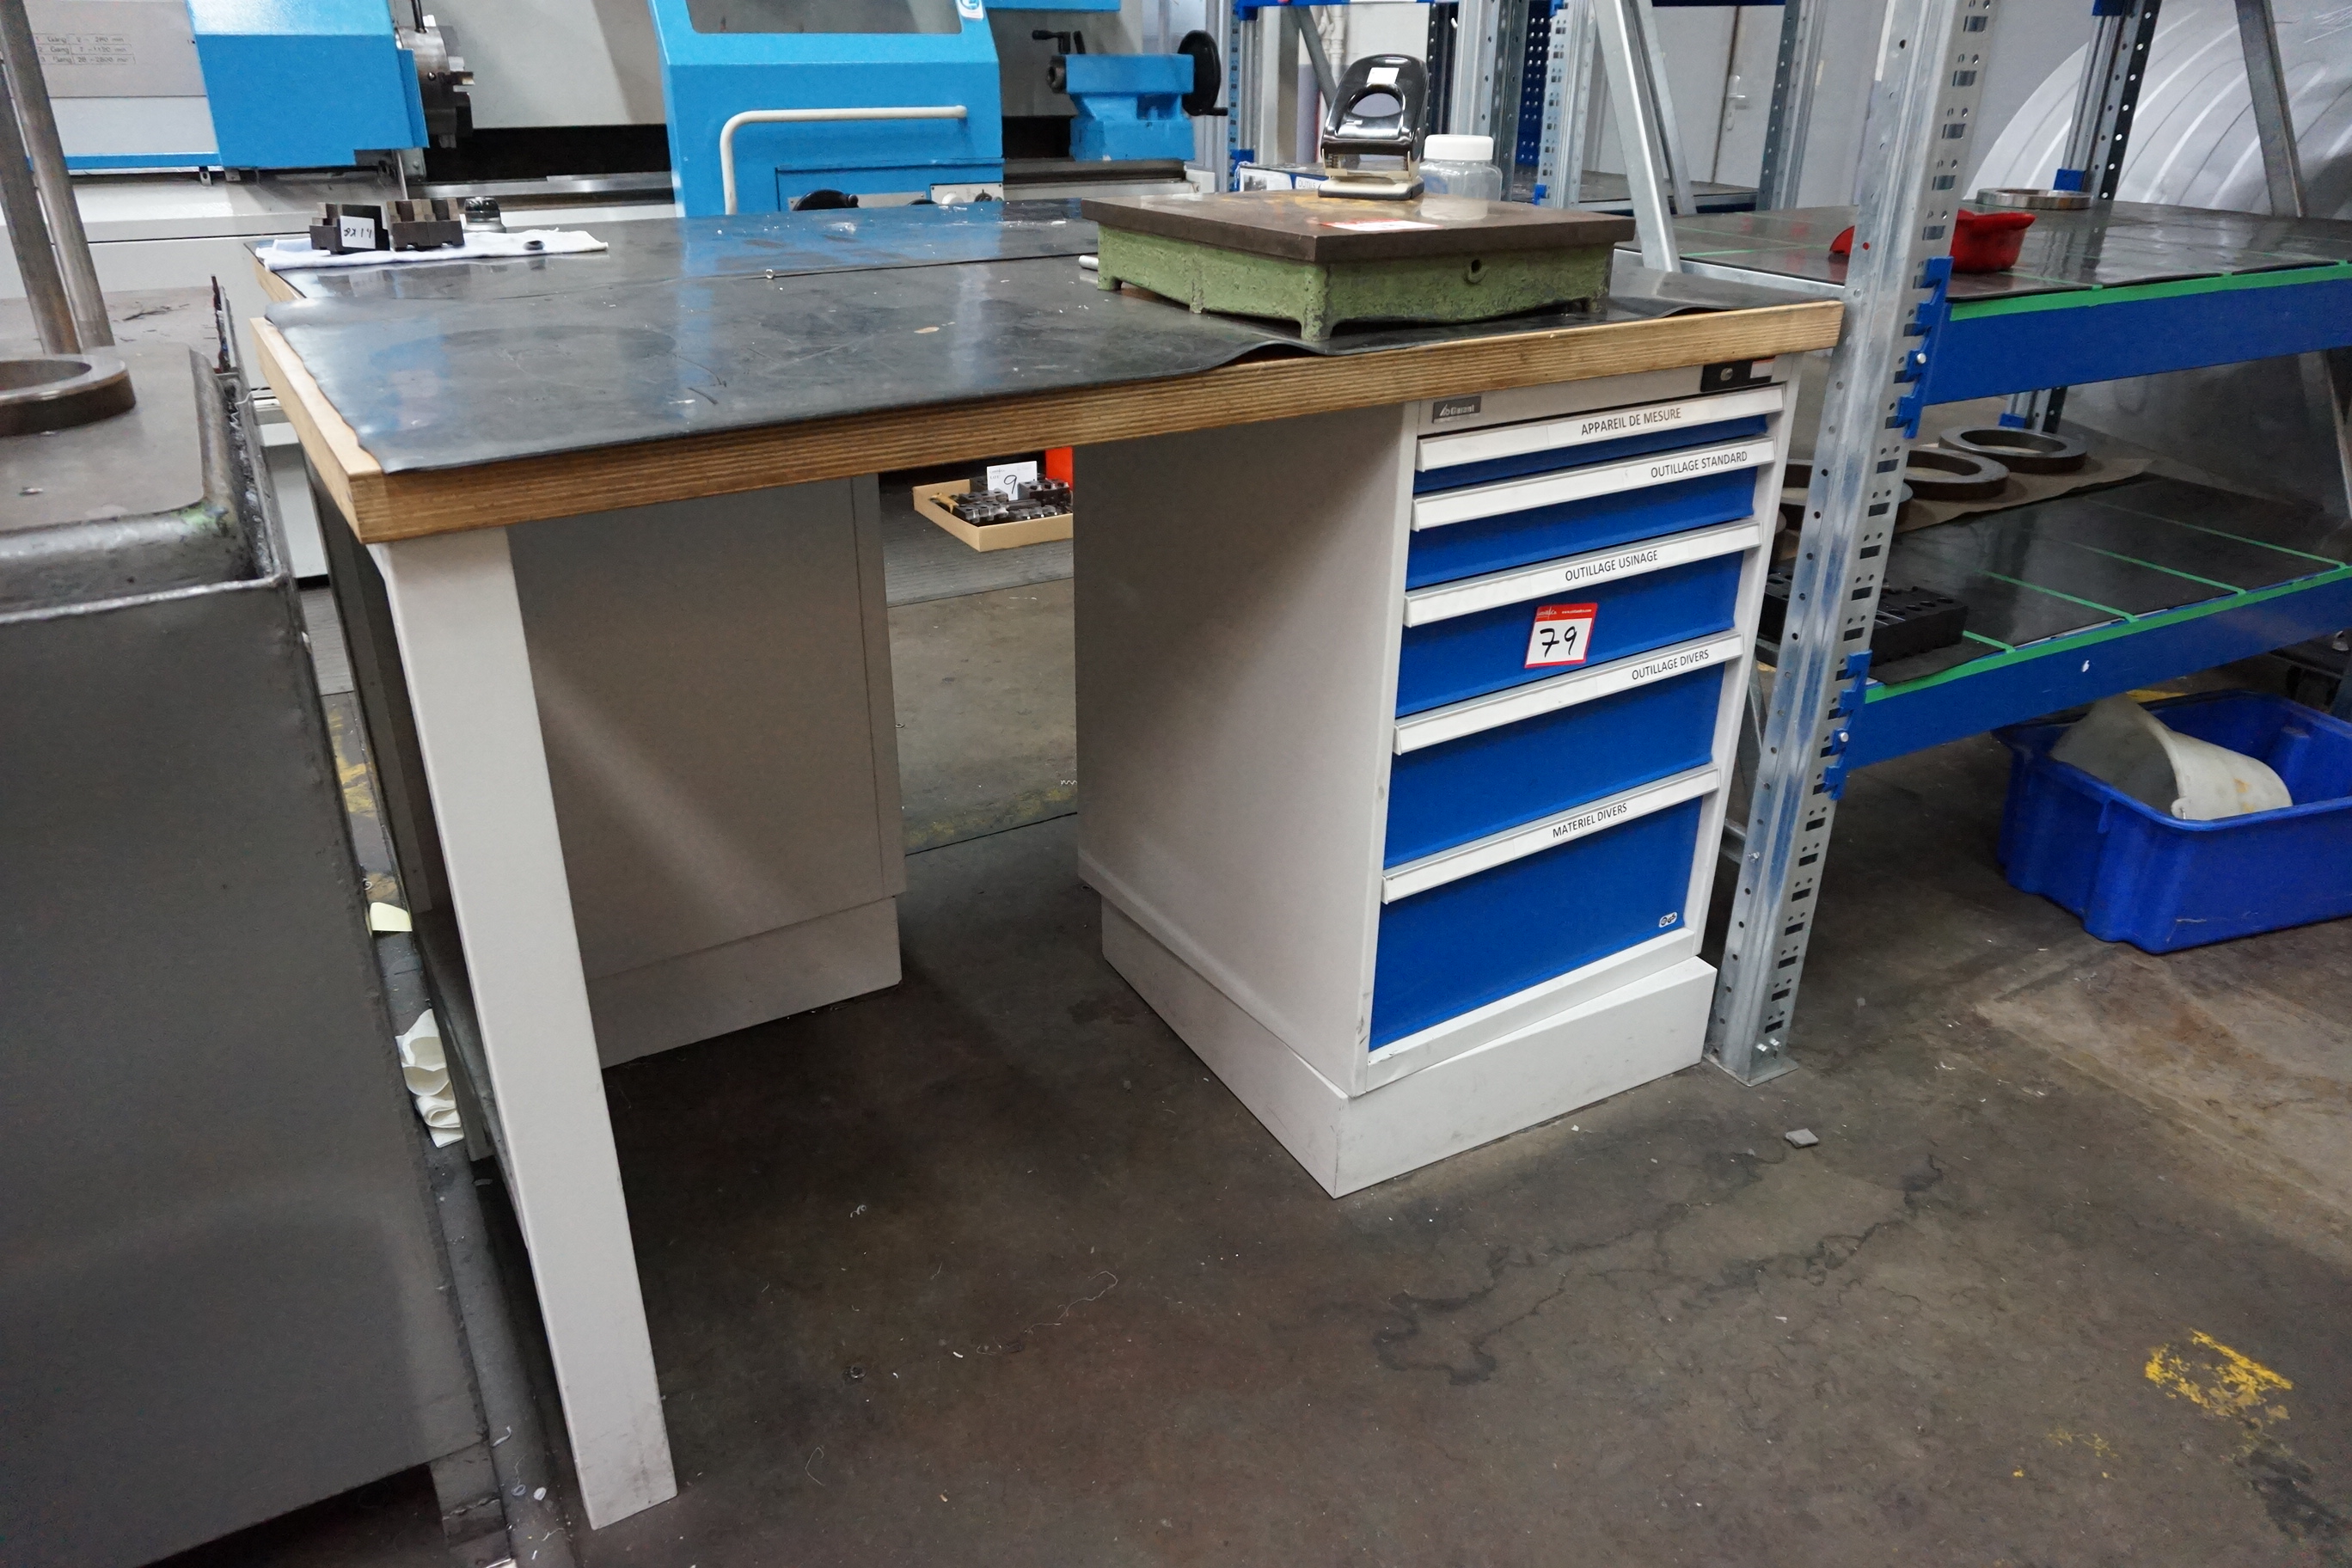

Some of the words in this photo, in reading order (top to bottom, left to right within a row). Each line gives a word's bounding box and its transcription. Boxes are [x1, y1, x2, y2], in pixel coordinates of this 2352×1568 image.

[1582, 417, 1626, 436] APPAREIL
[1629, 414, 1641, 426] DE
[1644, 407, 1681, 424] MESURE
[1651, 459, 1700, 478] OUTILLAGE
[1701, 450, 1748, 469] STANDARD
[1003, 475, 1017, 494] 9
[1565, 560, 1616, 581] OUTILLAGE
[1619, 550, 1658, 569] USINAGE
[1540, 626, 1577, 658] 79
[1632, 658, 1678, 680] OUTILLAGE
[1680, 649, 1709, 666] DIVERS
[1553, 815, 1596, 838] MATERIEL
[1597, 803, 1627, 822] DIVERS
